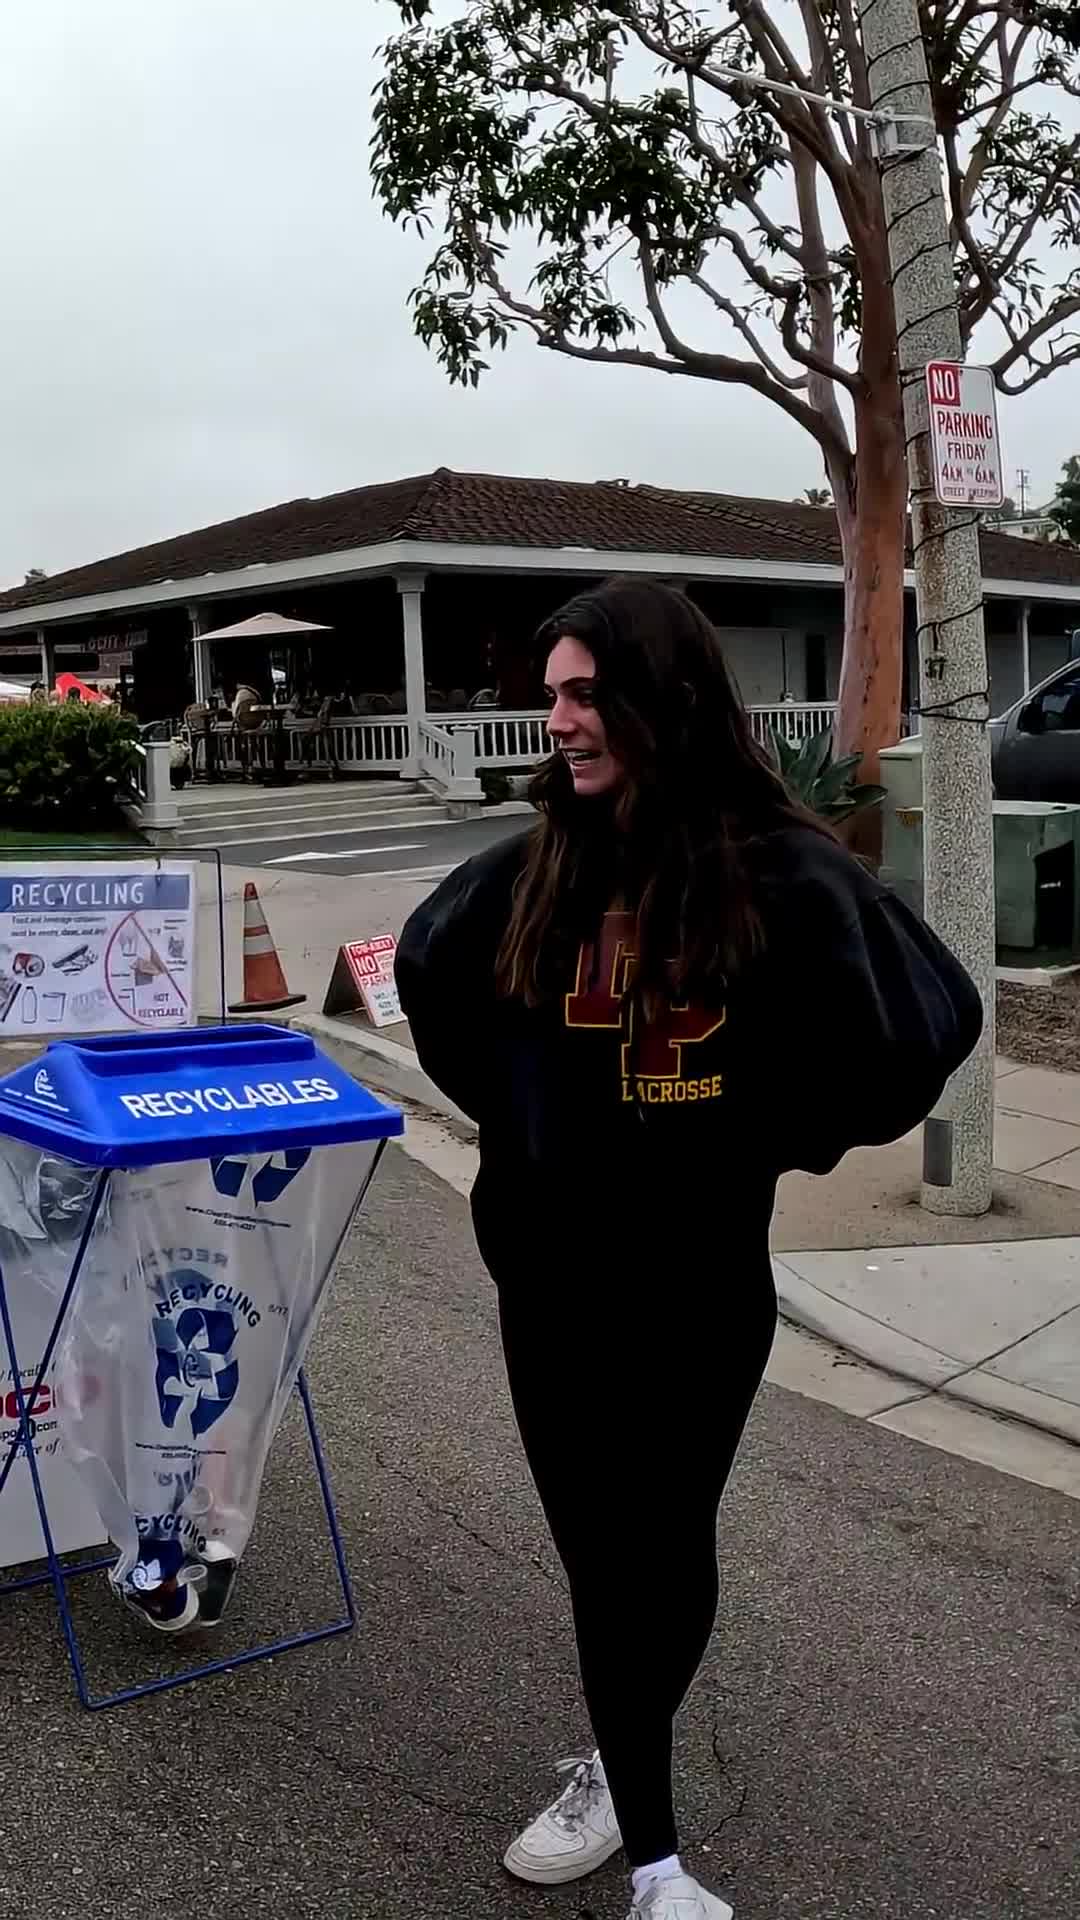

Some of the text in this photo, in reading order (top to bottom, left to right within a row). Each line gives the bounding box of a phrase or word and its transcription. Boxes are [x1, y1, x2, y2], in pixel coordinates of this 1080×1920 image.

[932, 369, 956, 399] NO
[937, 411, 993, 439] PARKING
[948, 442, 986, 461] FRIDAY
[11, 882, 145, 907] RECYCLING
[355, 954, 378, 975] NO
[120, 1078, 339, 1119] RECYCLABLES
[622, 1075, 724, 1103] LACROSSE
[155, 1283, 261, 1328] RECYCLING
